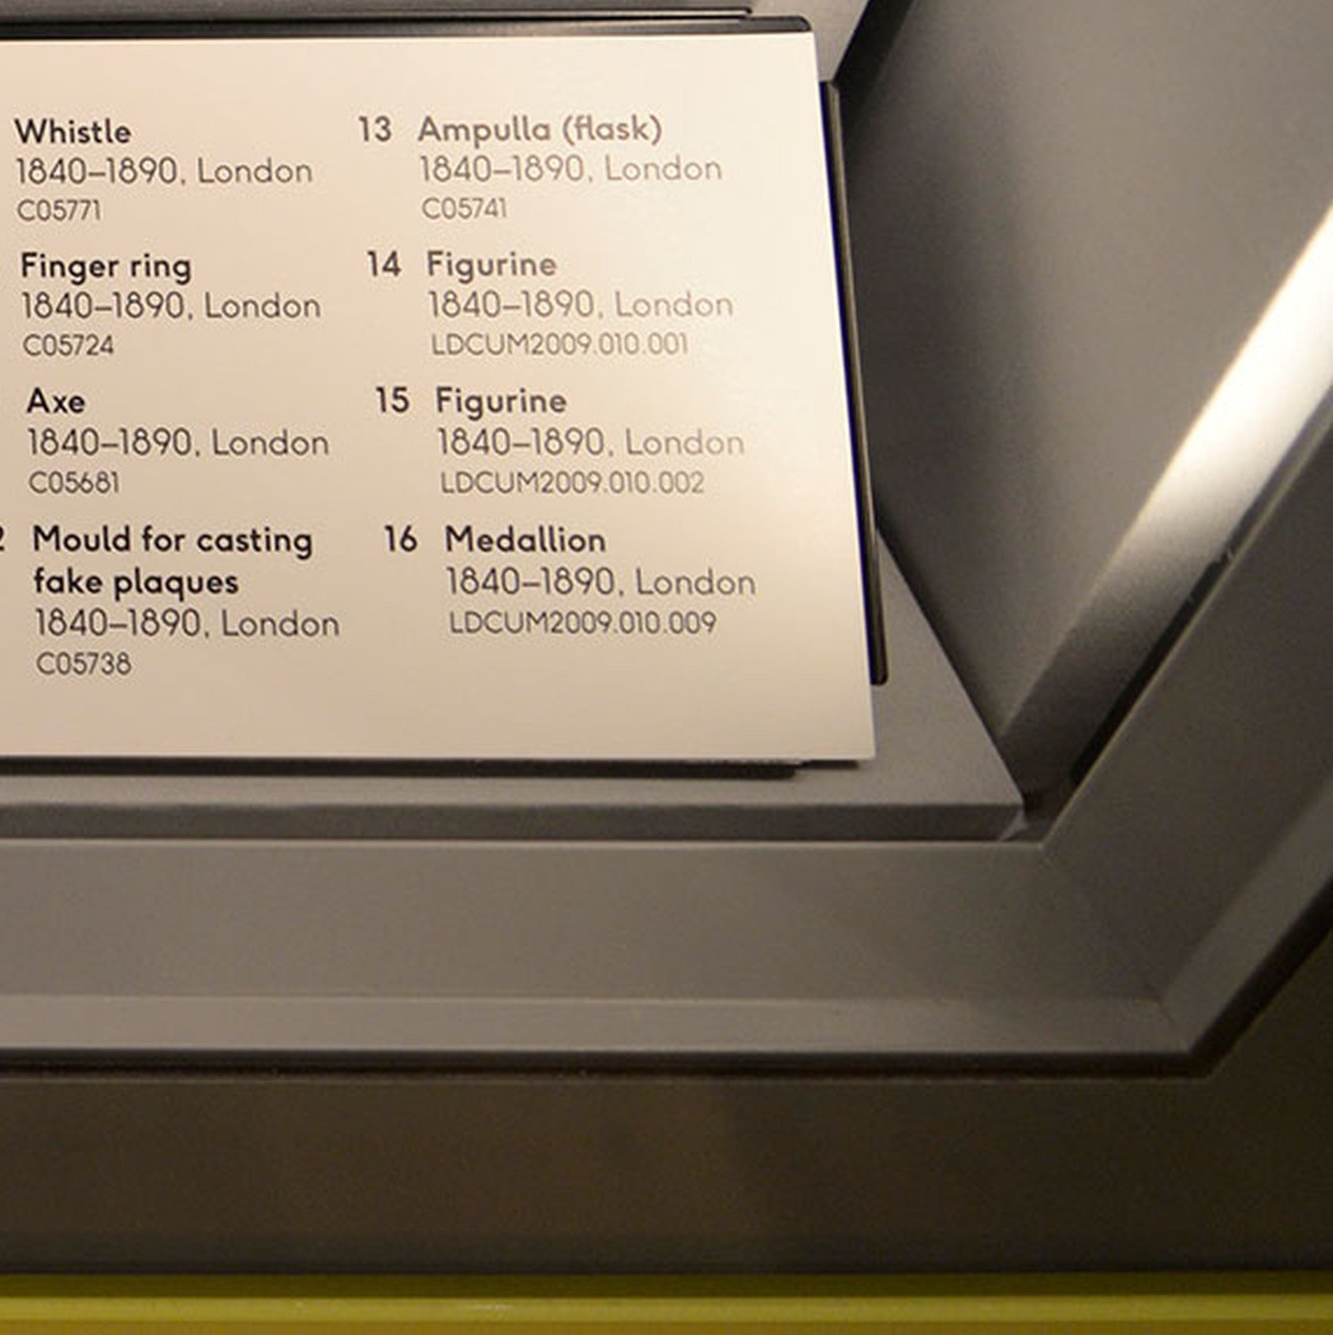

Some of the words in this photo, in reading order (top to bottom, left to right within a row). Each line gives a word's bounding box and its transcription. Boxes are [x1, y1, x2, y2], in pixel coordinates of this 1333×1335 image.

[13, 117, 132, 145] Whistle
[358, 114, 393, 143] 13
[417, 114, 552, 150] Ampulla
[562, 113, 663, 147] (flask)
[16, 198, 101, 223] C05771
[421, 196, 507, 221] C05741
[21, 251, 120, 287] Finger
[130, 252, 192, 286] ring
[366, 249, 402, 278] 14
[426, 249, 558, 286] Figurine
[22, 332, 115, 357] C05724
[431, 331, 688, 357] LDCUM2009.010.001
[26, 386, 86, 415] Axe
[375, 385, 410, 414] 15
[435, 385, 568, 422] Figurine
[28, 470, 119, 495] C05681
[440, 469, 705, 495] LDCUM2009.010.002
[32, 524, 131, 553] Mould
[141, 524, 187, 553] for
[196, 525, 313, 561] casting
[384, 524, 418, 553] 16
[445, 524, 606, 553] Medallion
[33, 566, 104, 595] fake
[113, 566, 239, 603] plaques
[449, 609, 718, 635] LDCUM2009.010.009
[35, 650, 133, 676] C05738
